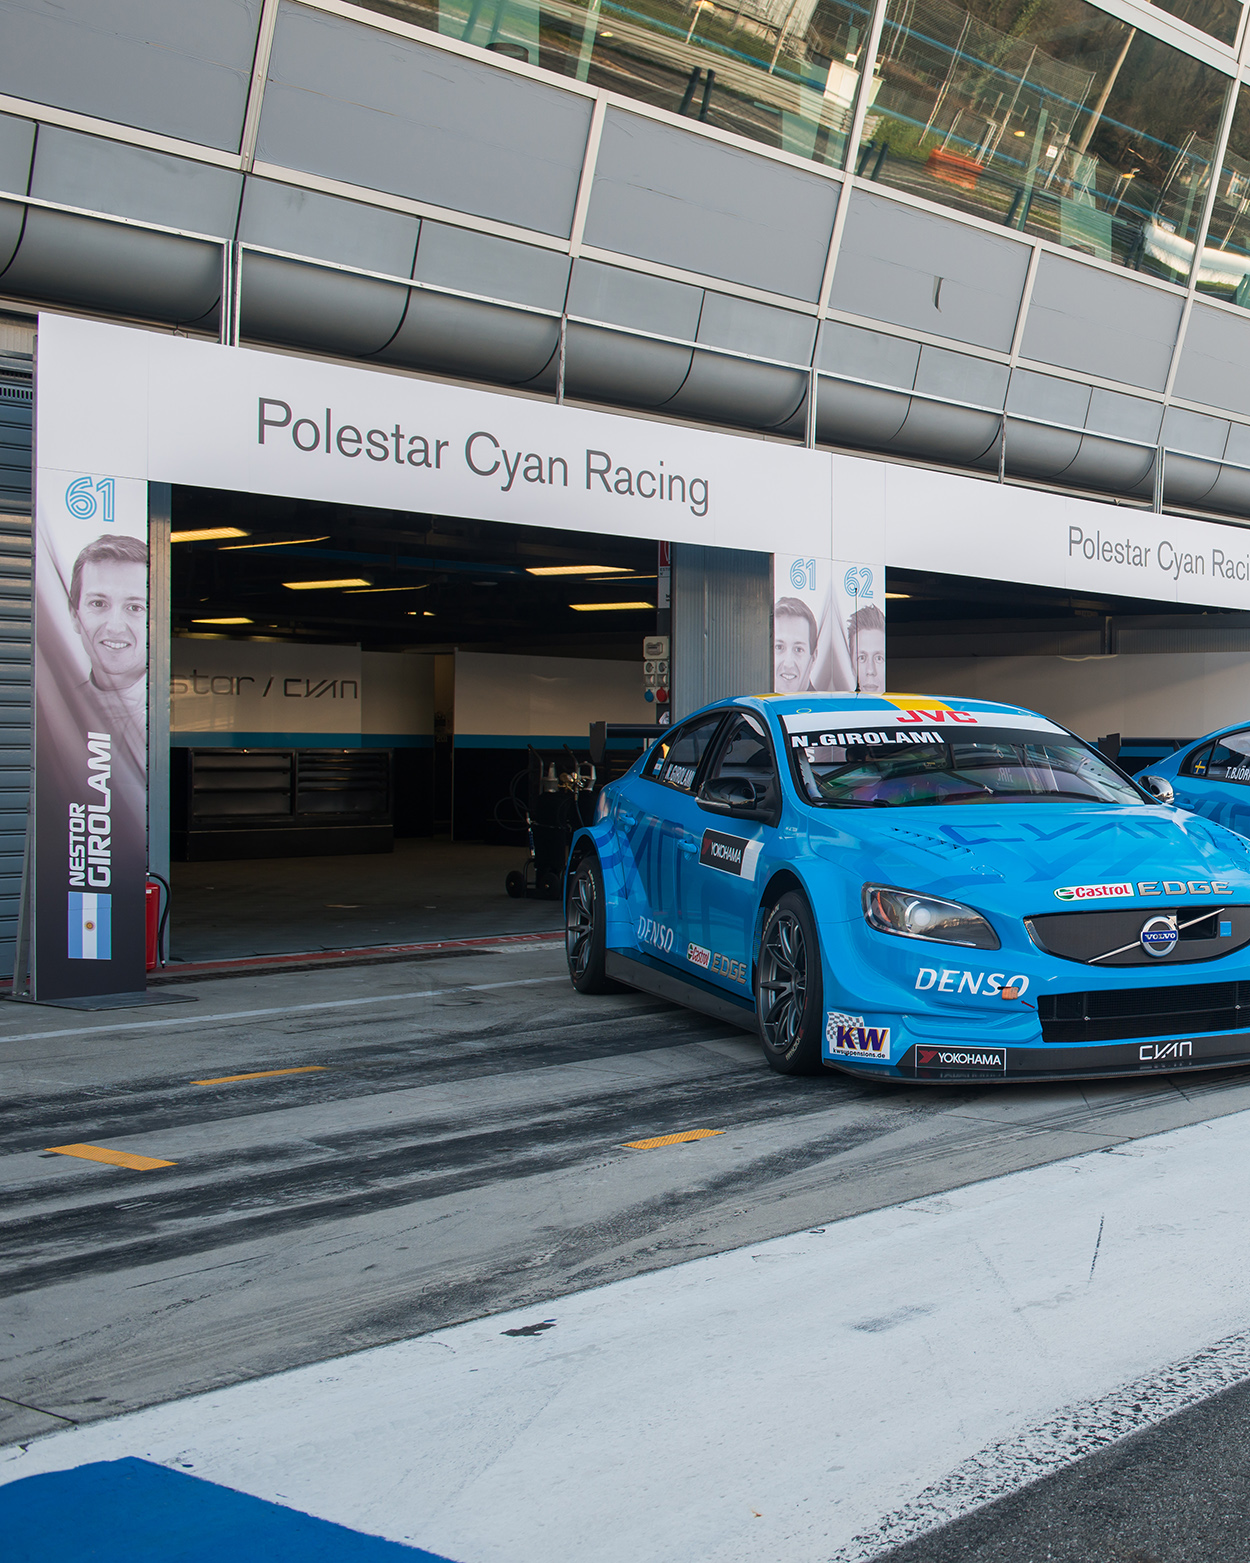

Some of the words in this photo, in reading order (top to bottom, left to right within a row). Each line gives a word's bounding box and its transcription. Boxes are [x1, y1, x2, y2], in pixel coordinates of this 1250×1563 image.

[257, 396, 449, 469] Polestar
[464, 431, 568, 492] Cyan
[585, 448, 710, 517] Racing
[65, 476, 115, 522] 61
[1068, 525, 1151, 568] Polestar
[1157, 540, 1205, 581] Cyan
[789, 558, 816, 591] 61
[843, 566, 874, 599] 62
[895, 710, 978, 724] JVC
[791, 731, 945, 748] N.GIROLAMI
[87, 731, 112, 888] GIROLAMI
[68, 802, 86, 887] NESTOR
[711, 841, 742, 864] YOKOHAMA
[1075, 884, 1130, 898] Castrol
[1137, 881, 1235, 896] EDGE
[637, 915, 674, 954] DENSO
[1144, 932, 1176, 941] VOLVO
[710, 952, 748, 985] EDGE
[914, 967, 1030, 998] DENSO
[836, 1025, 889, 1052] KW
[937, 1052, 1002, 1066] YOKOHAMA
